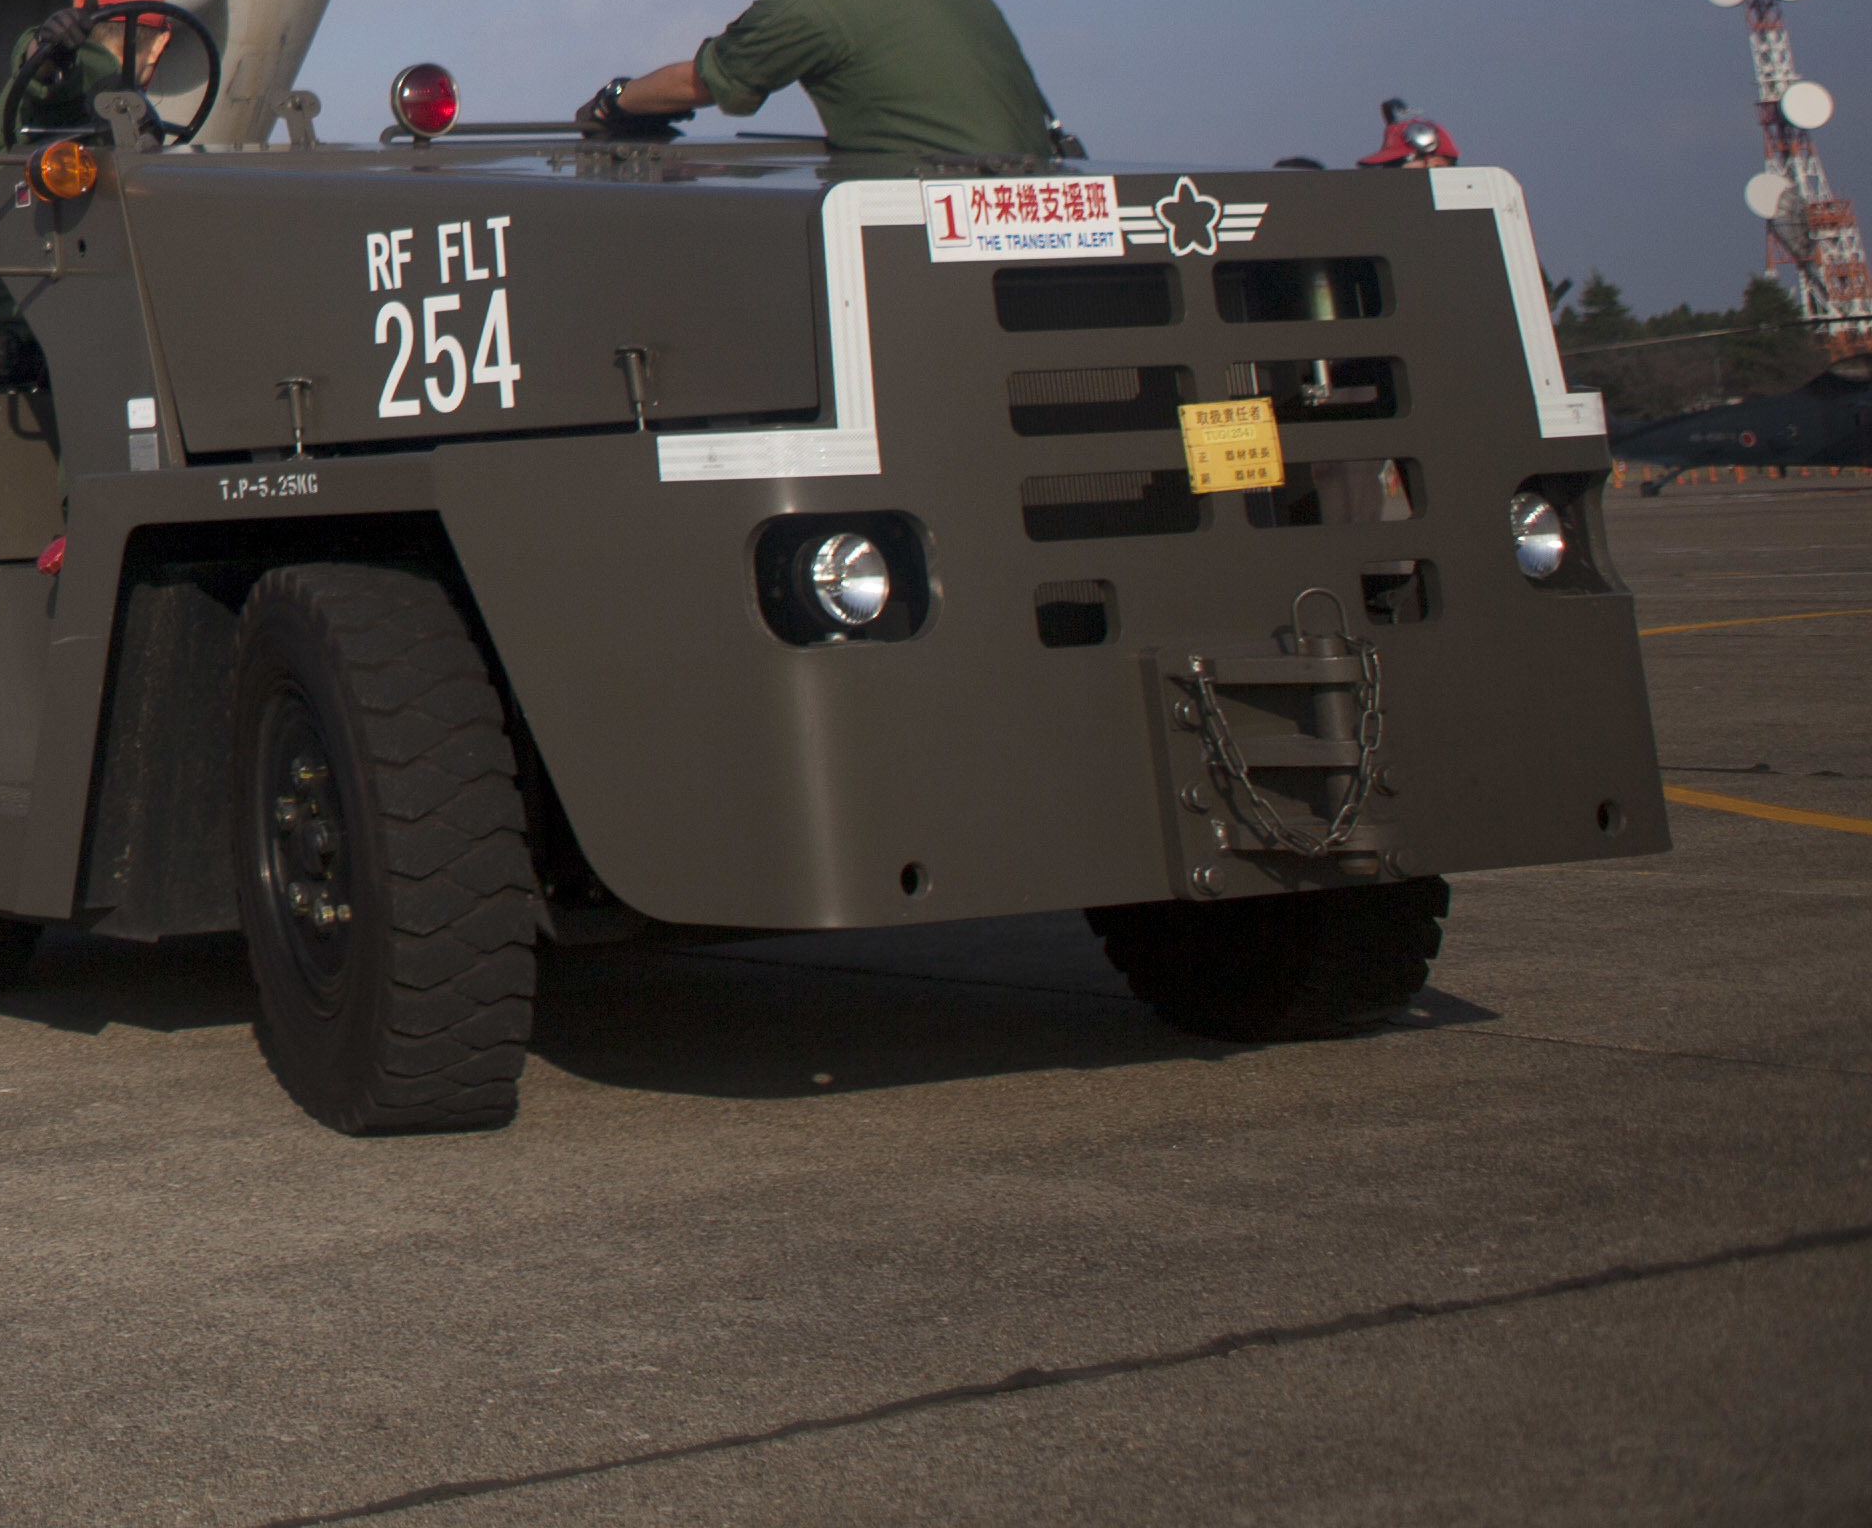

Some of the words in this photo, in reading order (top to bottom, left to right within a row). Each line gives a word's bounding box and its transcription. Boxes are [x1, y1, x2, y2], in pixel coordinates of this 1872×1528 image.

[934, 194, 967, 241] 1
[970, 182, 1109, 225] 外来機支援班
[977, 235, 1002, 251] THE
[1006, 233, 1072, 250] TRANSIENT
[1078, 231, 1114, 248] ALERT
[366, 227, 414, 292] RF
[437, 215, 511, 284] FLT
[374, 288, 522, 418] 254
[219, 473, 319, 501] T.P-5.25KG
